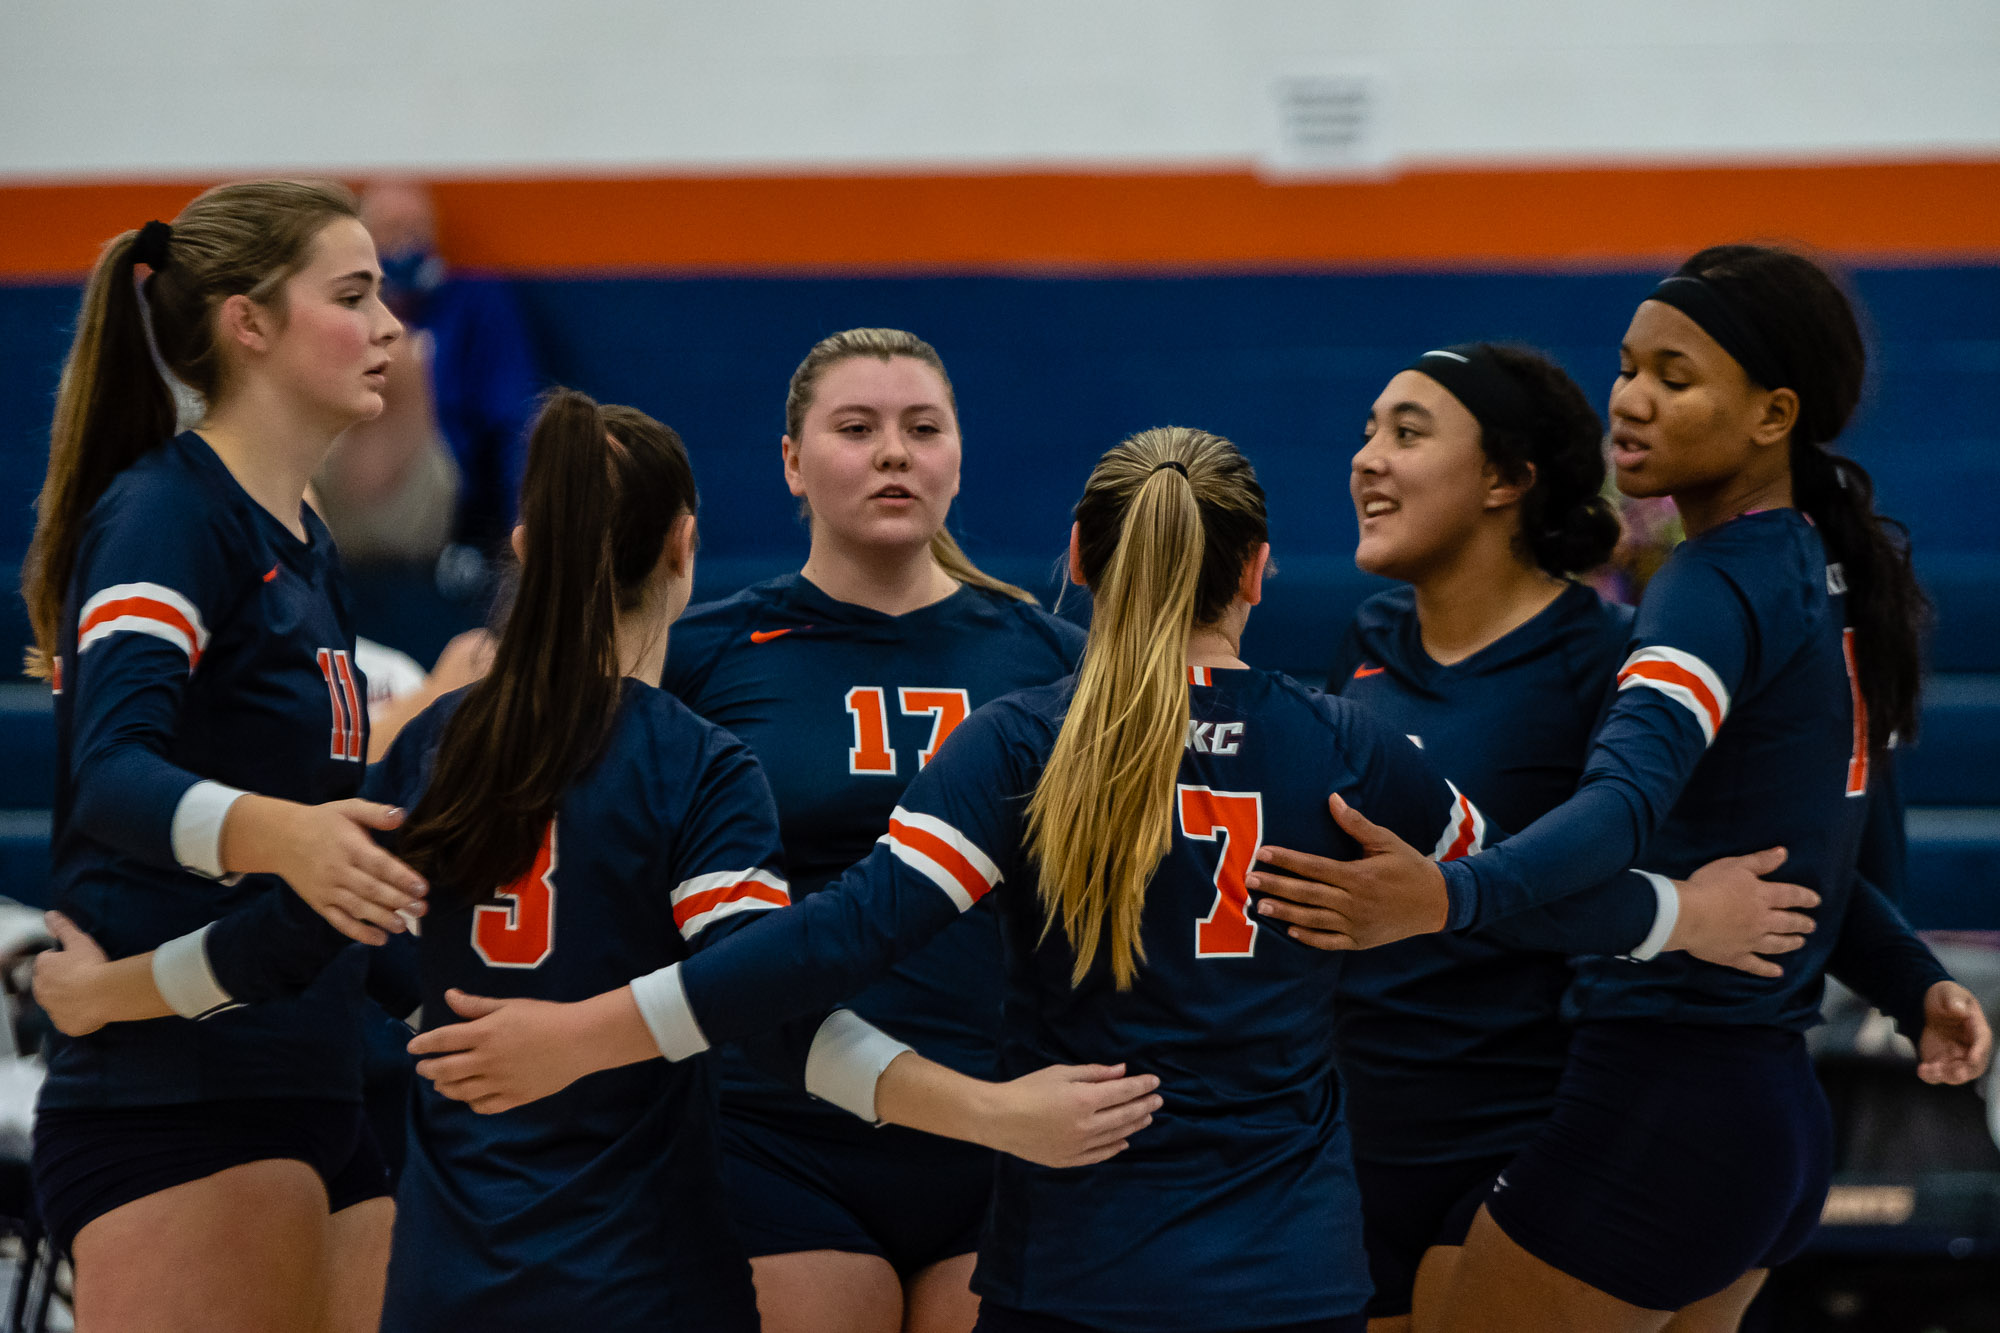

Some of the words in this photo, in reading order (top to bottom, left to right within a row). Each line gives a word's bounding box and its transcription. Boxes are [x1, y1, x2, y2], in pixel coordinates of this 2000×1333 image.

[316, 647, 364, 763] 11
[844, 685, 971, 775] 17
[470, 811, 559, 970] 3
[1177, 783, 1264, 960] 7
